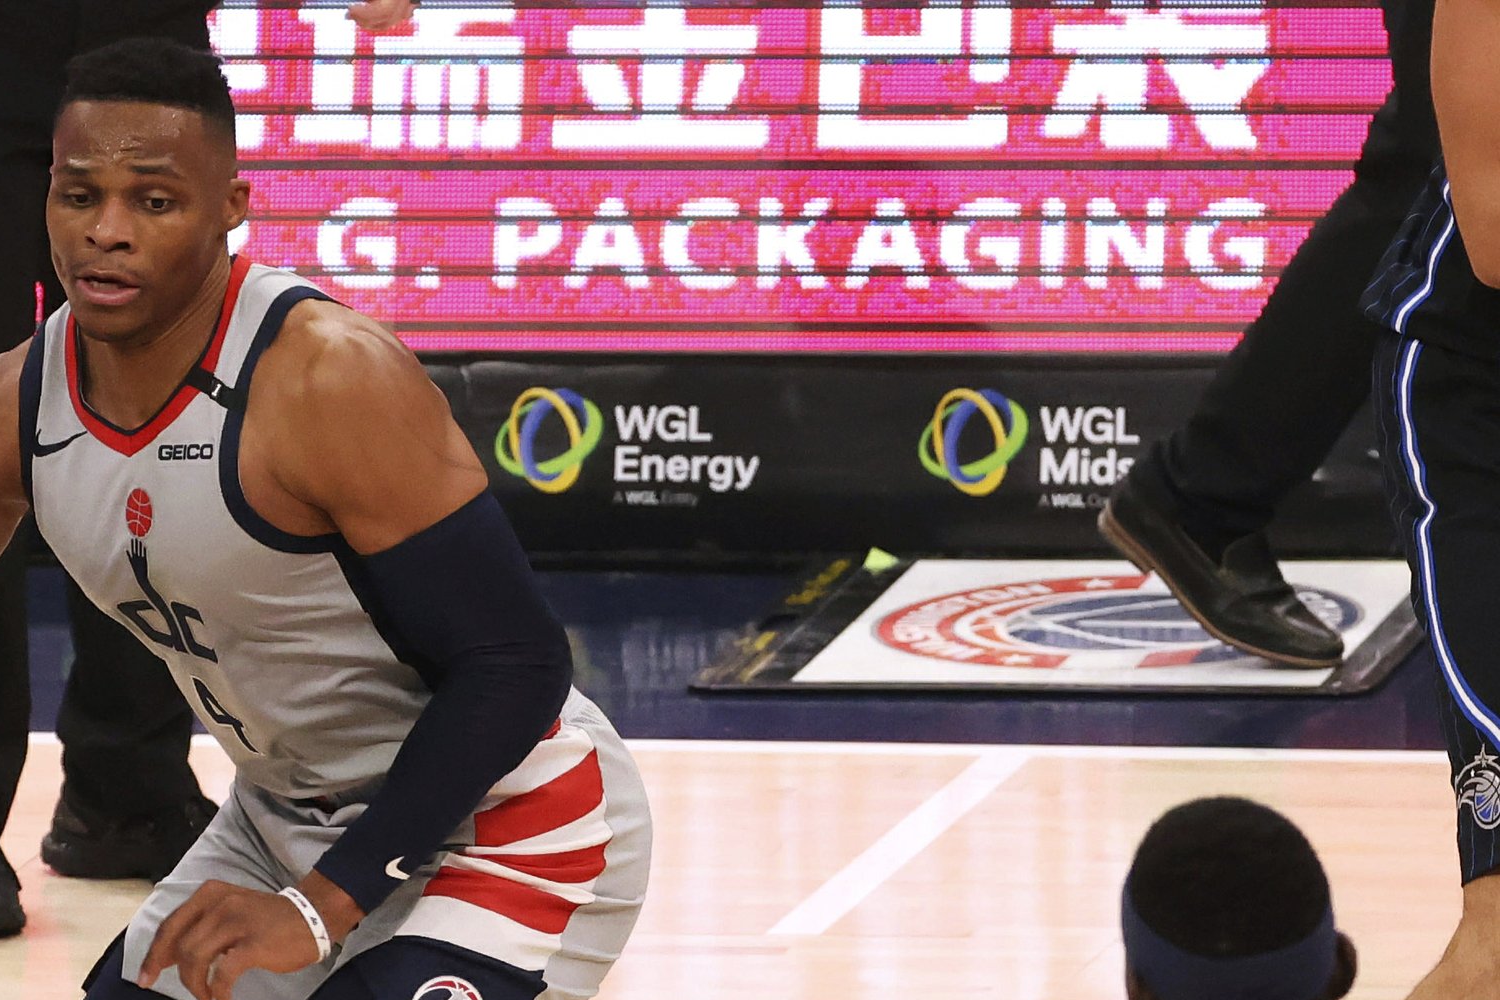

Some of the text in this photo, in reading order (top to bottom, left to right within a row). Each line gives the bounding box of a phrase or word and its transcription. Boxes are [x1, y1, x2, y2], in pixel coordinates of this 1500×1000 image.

[492, 196, 1267, 290] PACKAGING
[613, 405, 713, 443] WGL
[1040, 405, 1140, 445] WGL
[158, 443, 214, 461] GEICO
[613, 446, 760, 493] Energy
